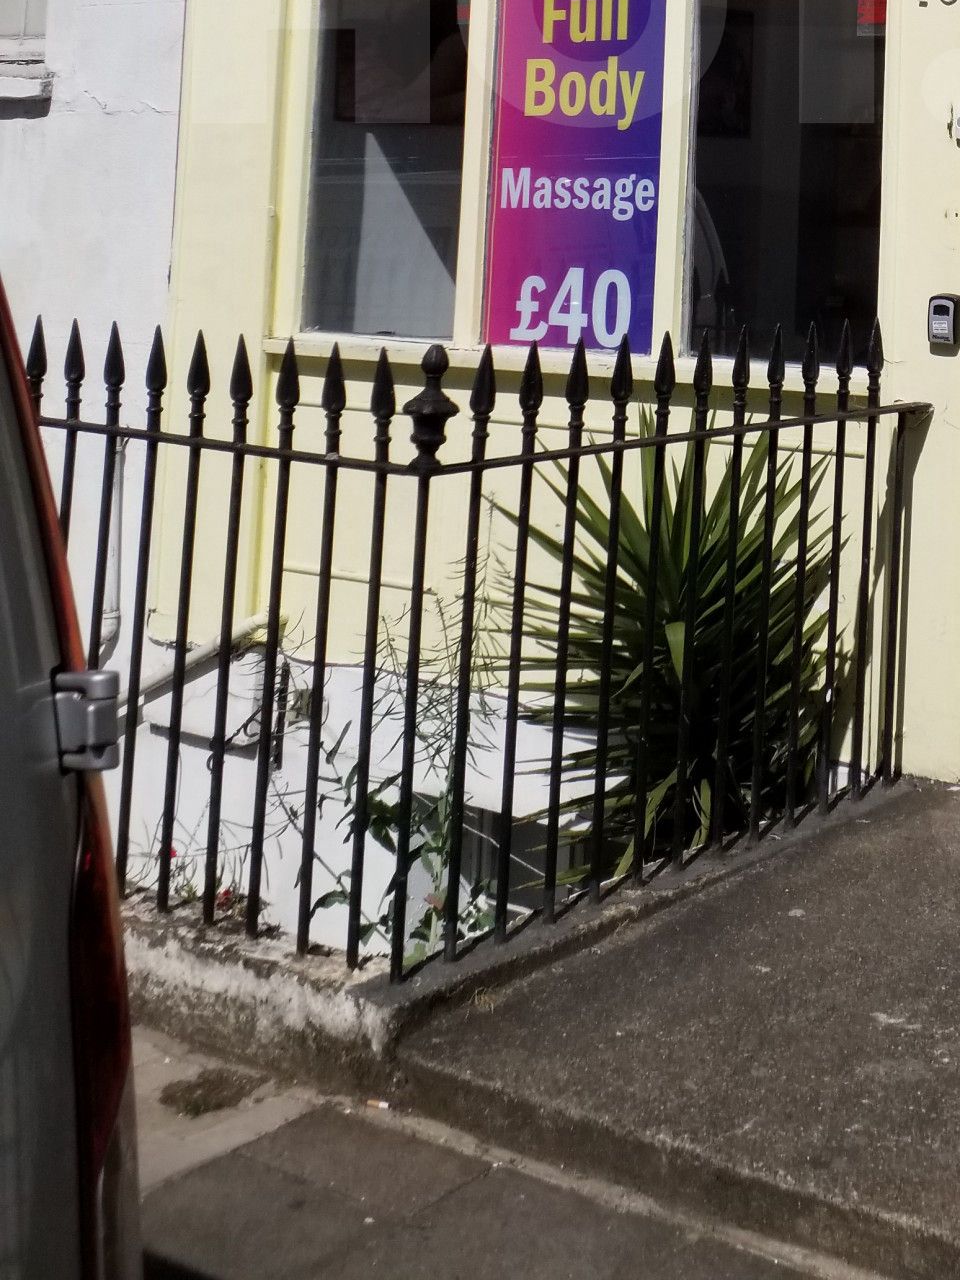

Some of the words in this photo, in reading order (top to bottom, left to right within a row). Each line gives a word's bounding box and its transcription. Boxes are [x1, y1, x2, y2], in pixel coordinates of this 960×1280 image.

[524, 56, 645, 131] Body
[500, 167, 655, 221] Massage
[510, 267, 632, 348] £40
